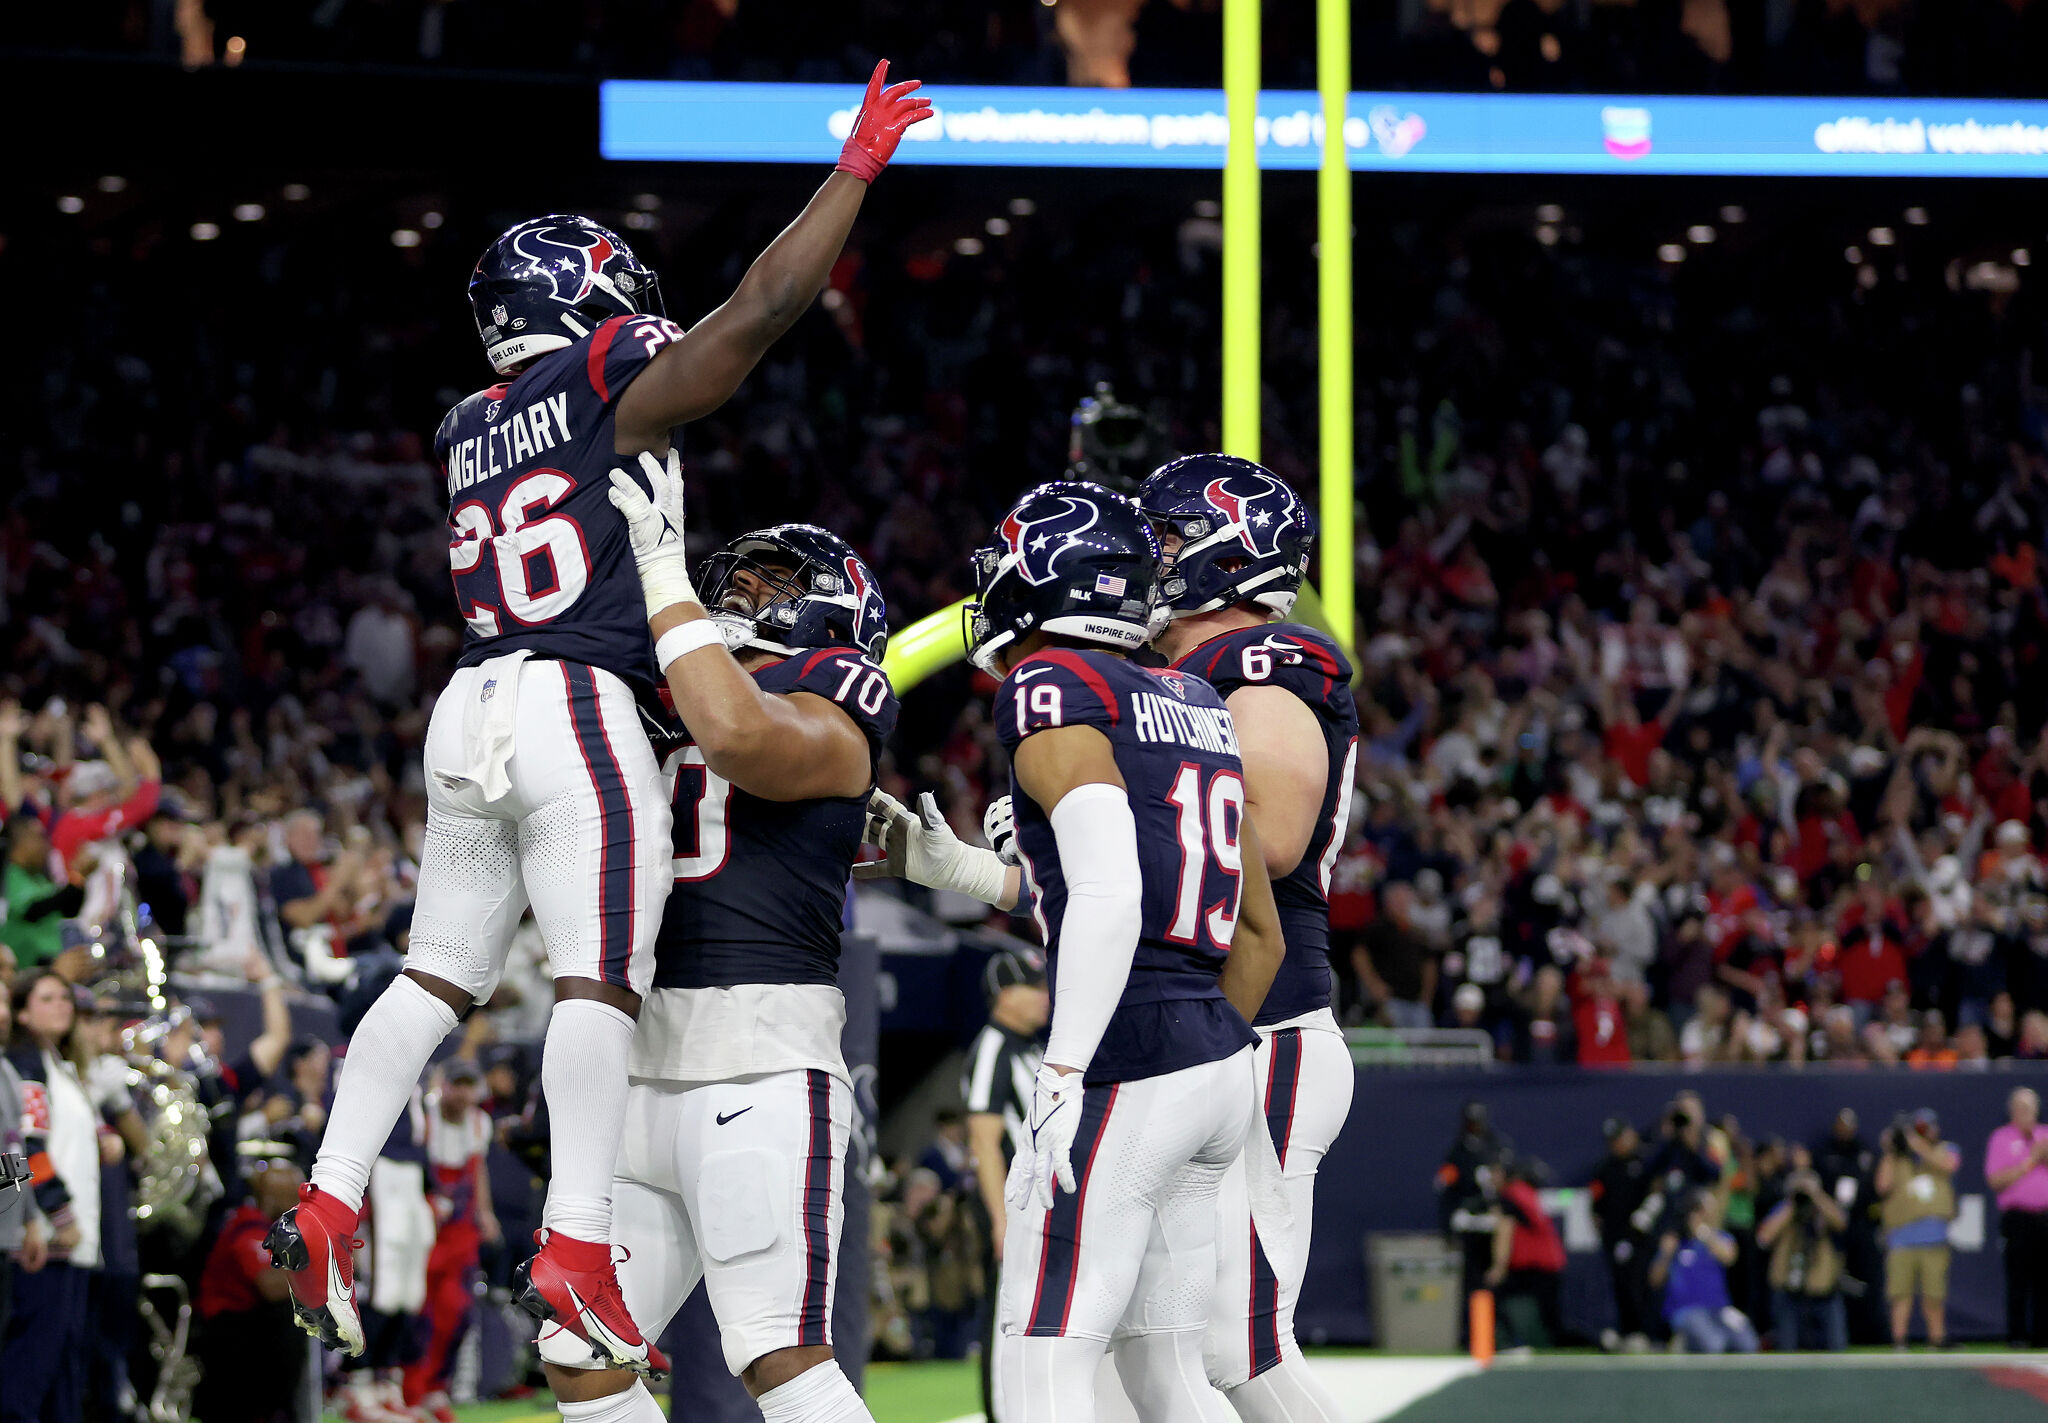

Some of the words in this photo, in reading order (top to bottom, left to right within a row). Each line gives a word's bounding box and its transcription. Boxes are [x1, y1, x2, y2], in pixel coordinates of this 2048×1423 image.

[502, 342, 526, 357] LOVE
[447, 467, 593, 638] 26
[1069, 588, 1093, 601] MLK
[1084, 623, 1124, 639] INSPIRE
[832, 658, 889, 716] 70
[1012, 683, 1063, 738] 19
[1164, 761, 1246, 951] 19
